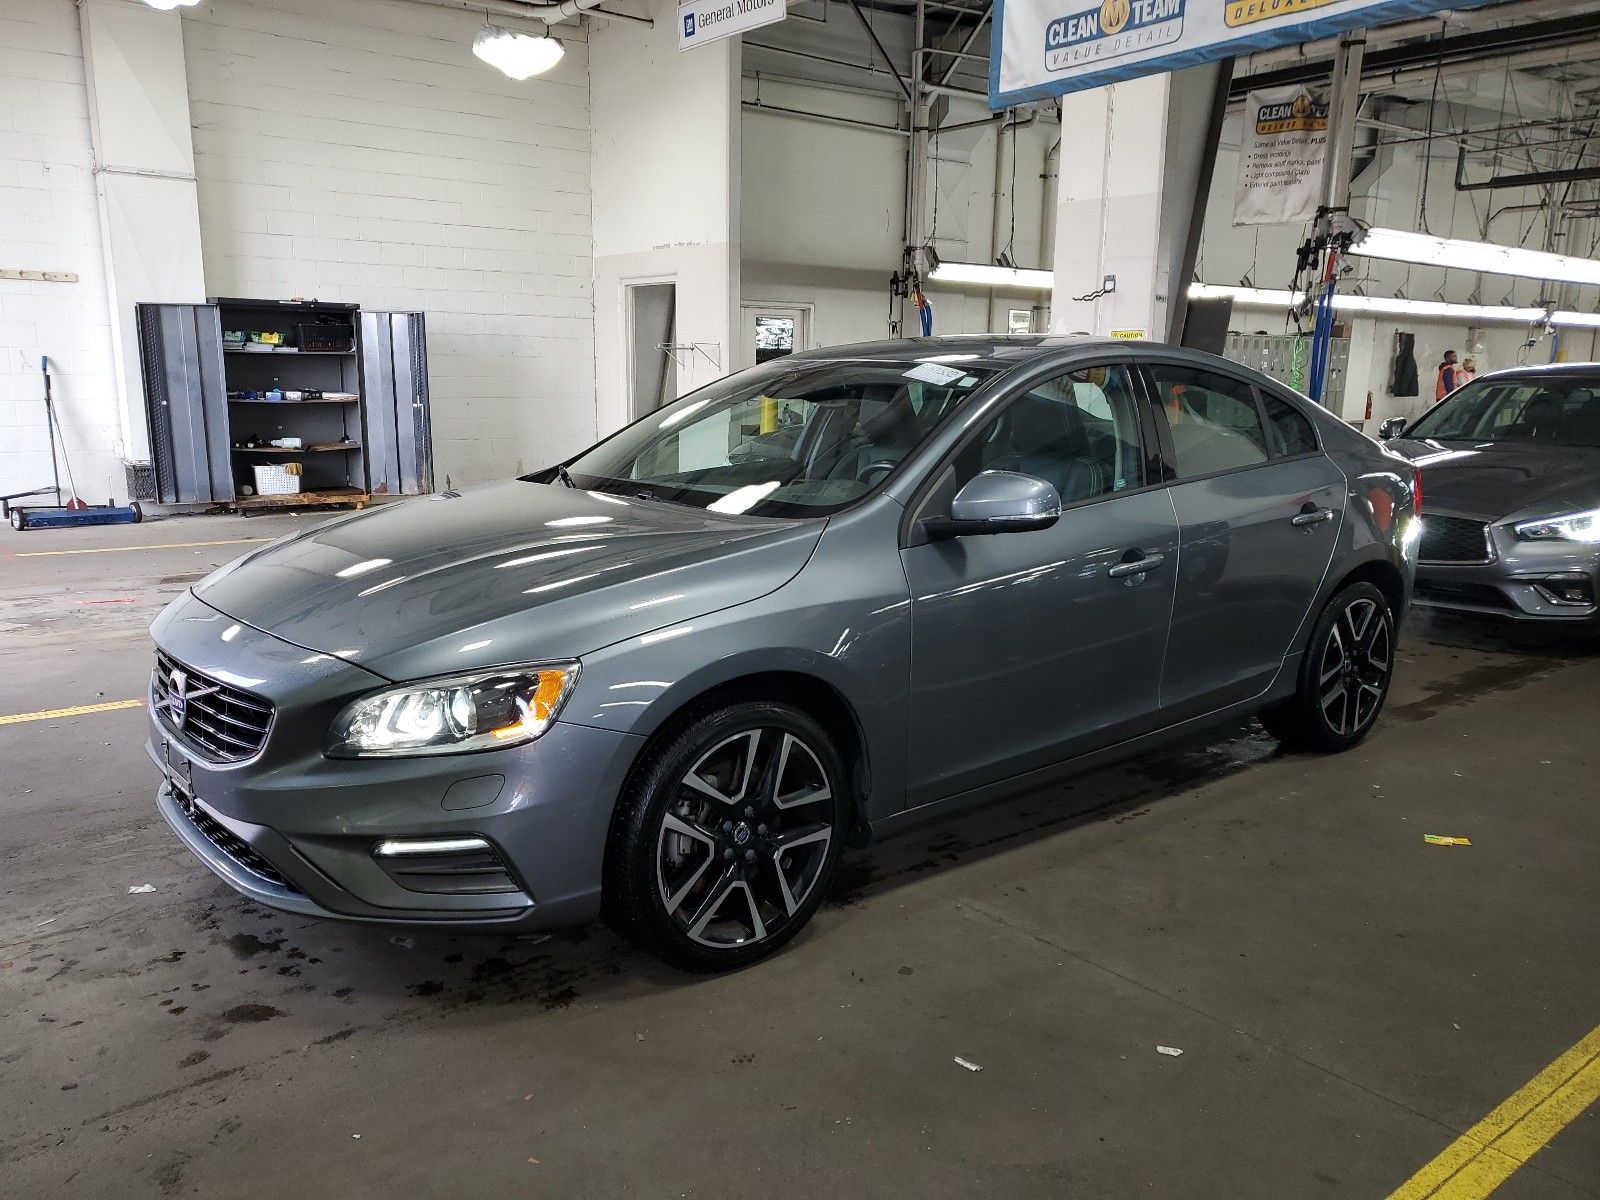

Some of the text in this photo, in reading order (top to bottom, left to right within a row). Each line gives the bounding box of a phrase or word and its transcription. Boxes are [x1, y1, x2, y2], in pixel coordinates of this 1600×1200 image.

[698, 3, 735, 28] General
[1235, 0, 1309, 19] DELUX
[1048, 12, 1098, 46] CLEAN
[1131, 0, 1180, 25] TEAM
[1053, 24, 1174, 65] VALUE DETAIL
[1259, 105, 1292, 120] CLEAN
[1312, 104, 1330, 118] TEA
[1261, 121, 1296, 131] DELUXE
